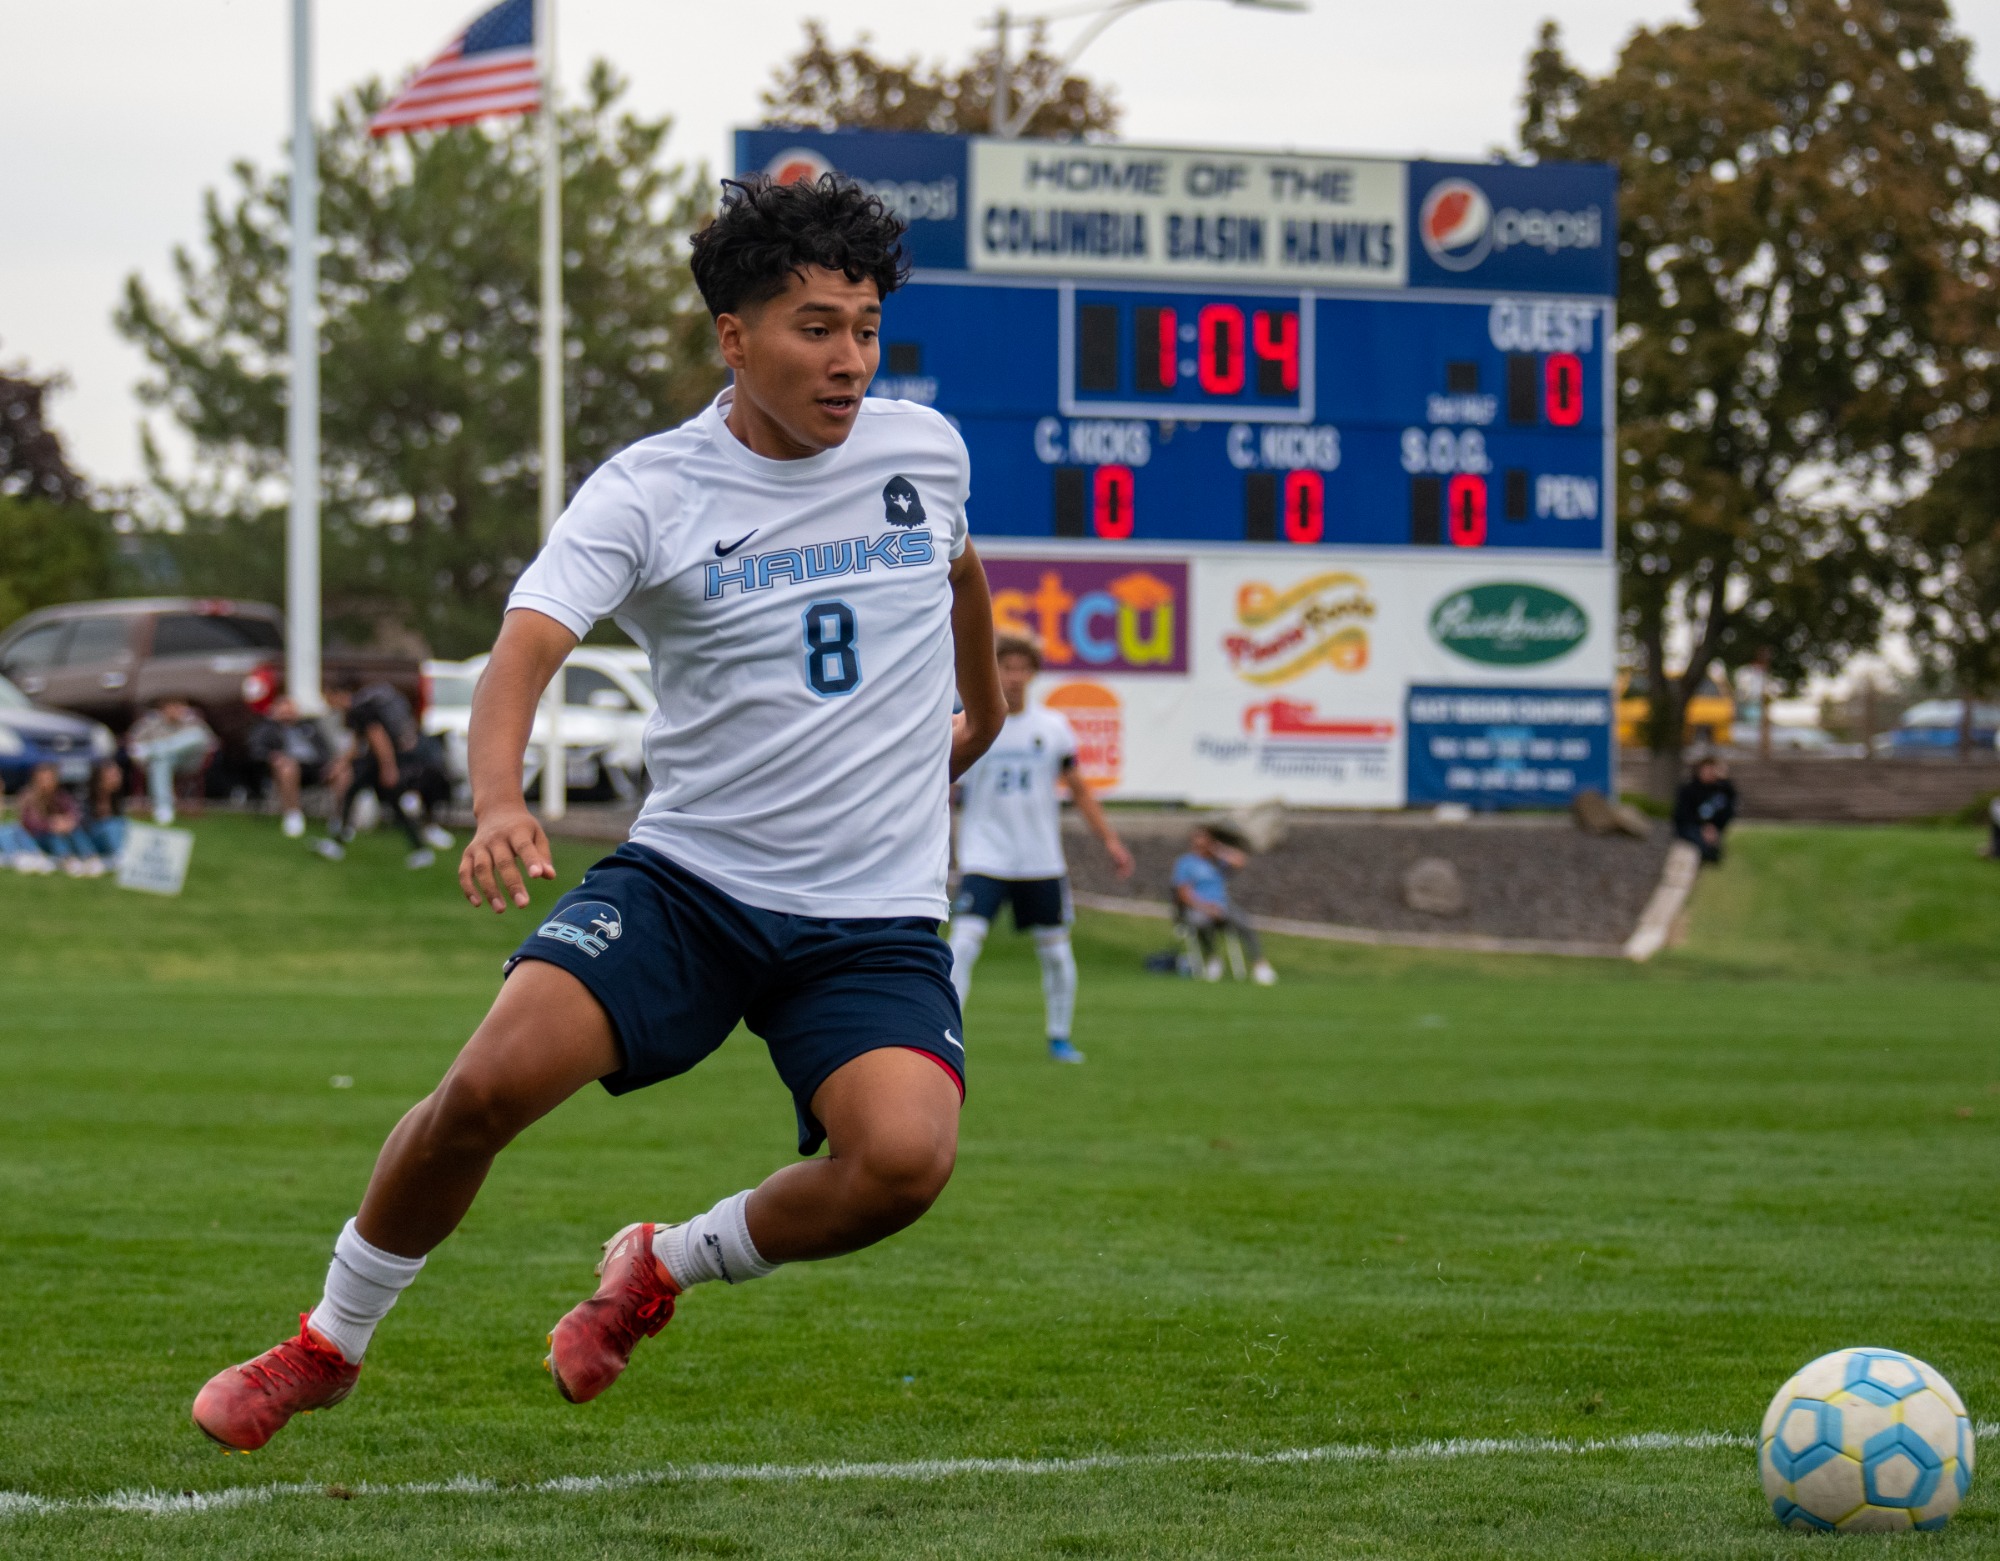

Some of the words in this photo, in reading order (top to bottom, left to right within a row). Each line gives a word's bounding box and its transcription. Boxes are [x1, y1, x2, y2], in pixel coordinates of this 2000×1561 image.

[1024, 156, 1169, 197] HOME
[1184, 160, 1246, 199] OF
[1267, 166, 1353, 204] THE
[983, 206, 1147, 257] COLUMBIA
[1166, 211, 1266, 262] BASIN
[1281, 218, 1396, 270] HAWKS
[1496, 204, 1600, 254] pepsi
[1158, 303, 1300, 396] 1:04
[1488, 298, 1600, 352] GUEST
[1545, 352, 1582, 427] 0
[1034, 416, 1066, 464] C.
[1068, 419, 1151, 467] KICKS
[1226, 422, 1258, 469] C.
[1260, 424, 1341, 472] KICKS
[1093, 464, 1134, 539] 0
[1284, 468, 1324, 544] 0
[1448, 473, 1487, 547] 0
[1535, 474, 1599, 521] PEN
[704, 528, 936, 601] HAWKS
[801, 598, 863, 698] 8
[537, 921, 609, 958] CBC
